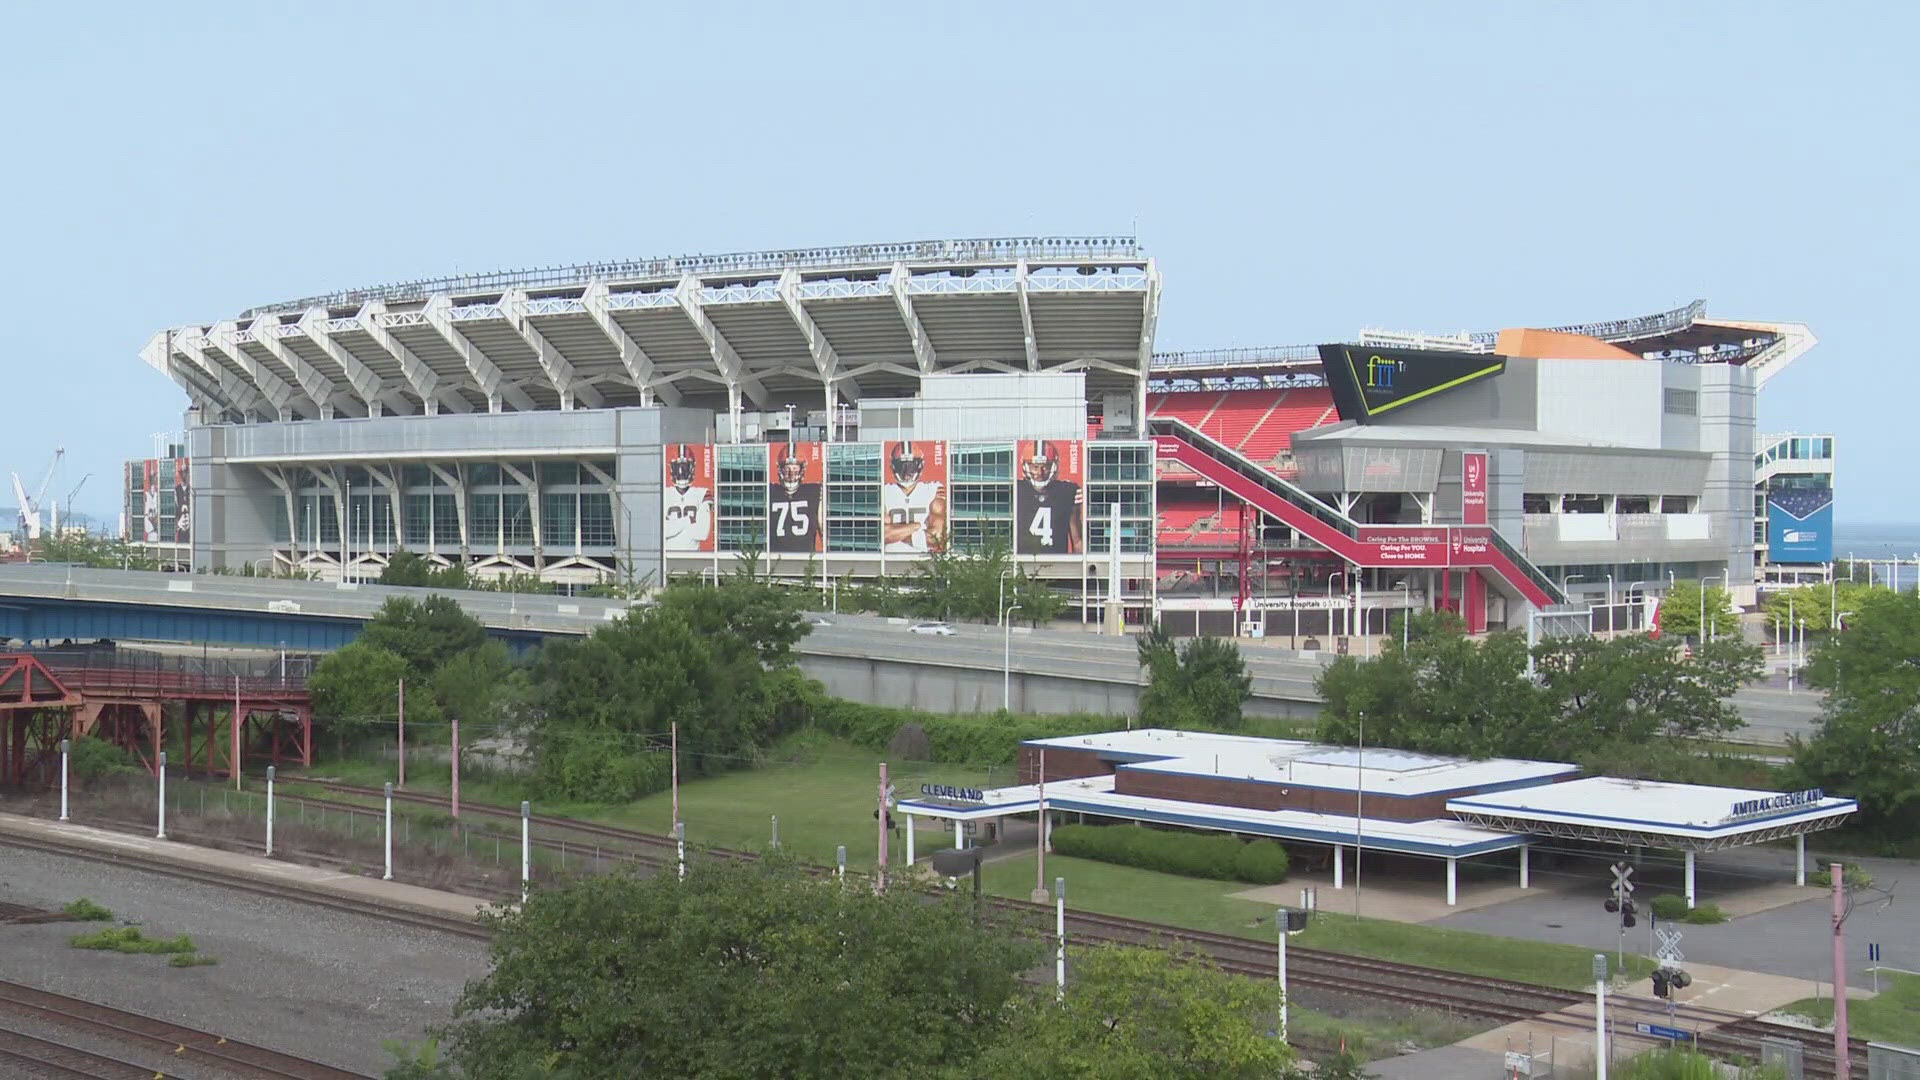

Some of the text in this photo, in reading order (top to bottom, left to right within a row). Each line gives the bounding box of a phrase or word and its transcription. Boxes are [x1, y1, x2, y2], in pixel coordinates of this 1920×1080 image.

[772, 501, 809, 537] 75
[1029, 506, 1053, 546] 4
[1464, 536, 1488, 545] University
[1380, 544, 1400, 552] Caring
[1463, 545, 1486, 553] Hospitals
[1254, 600, 1287, 608] Unversity
[921, 784, 984, 801] CLEVELAND
[1732, 788, 1824, 815] AMTRAK CLEVELAND
